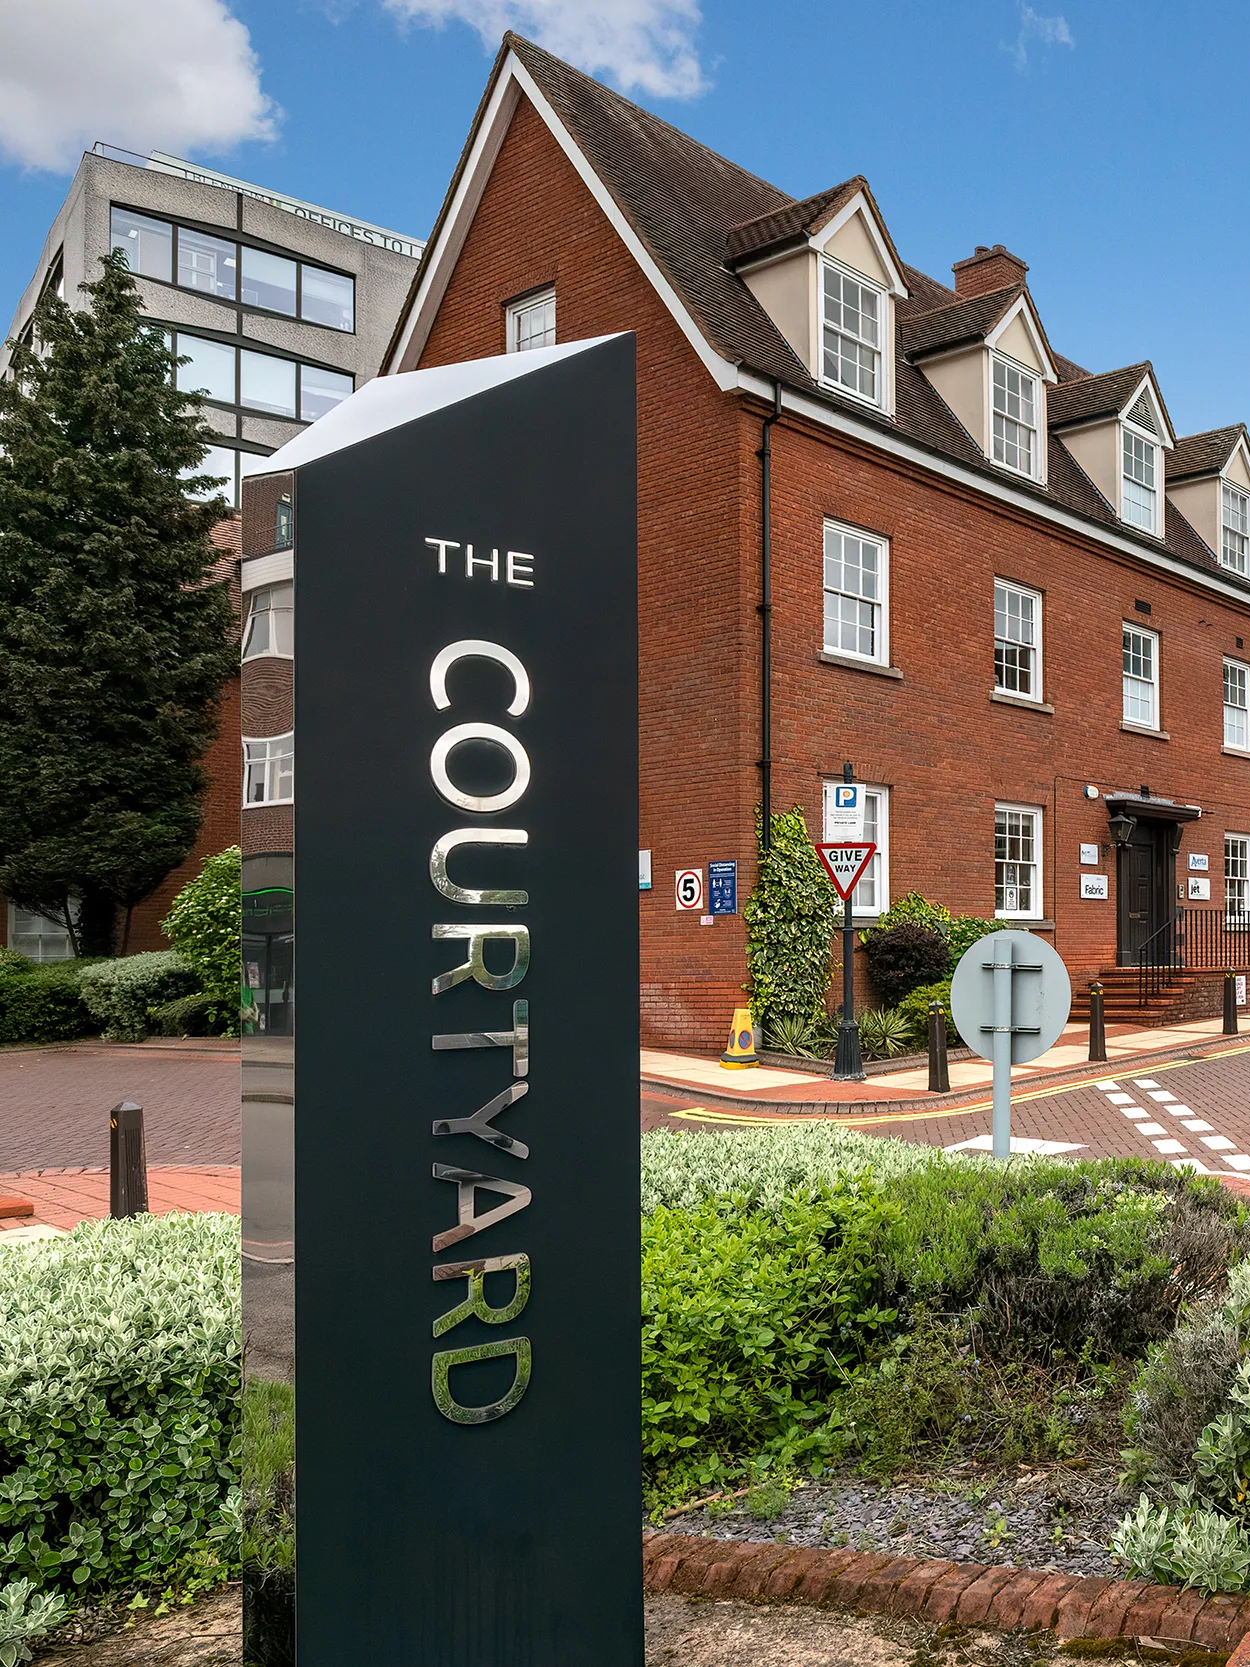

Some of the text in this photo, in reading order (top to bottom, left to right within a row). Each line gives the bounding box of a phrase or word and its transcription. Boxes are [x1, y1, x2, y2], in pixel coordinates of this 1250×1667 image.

[380, 234, 403, 253] TO
[424, 537, 535, 589] THE
[839, 788, 855, 806] P
[829, 850, 862, 862] GIVE
[835, 864, 856, 872] WAY
[682, 878, 695, 902] 5
[1085, 884, 1104, 895] Fabric
[429, 638, 533, 1426] COURTYARD
